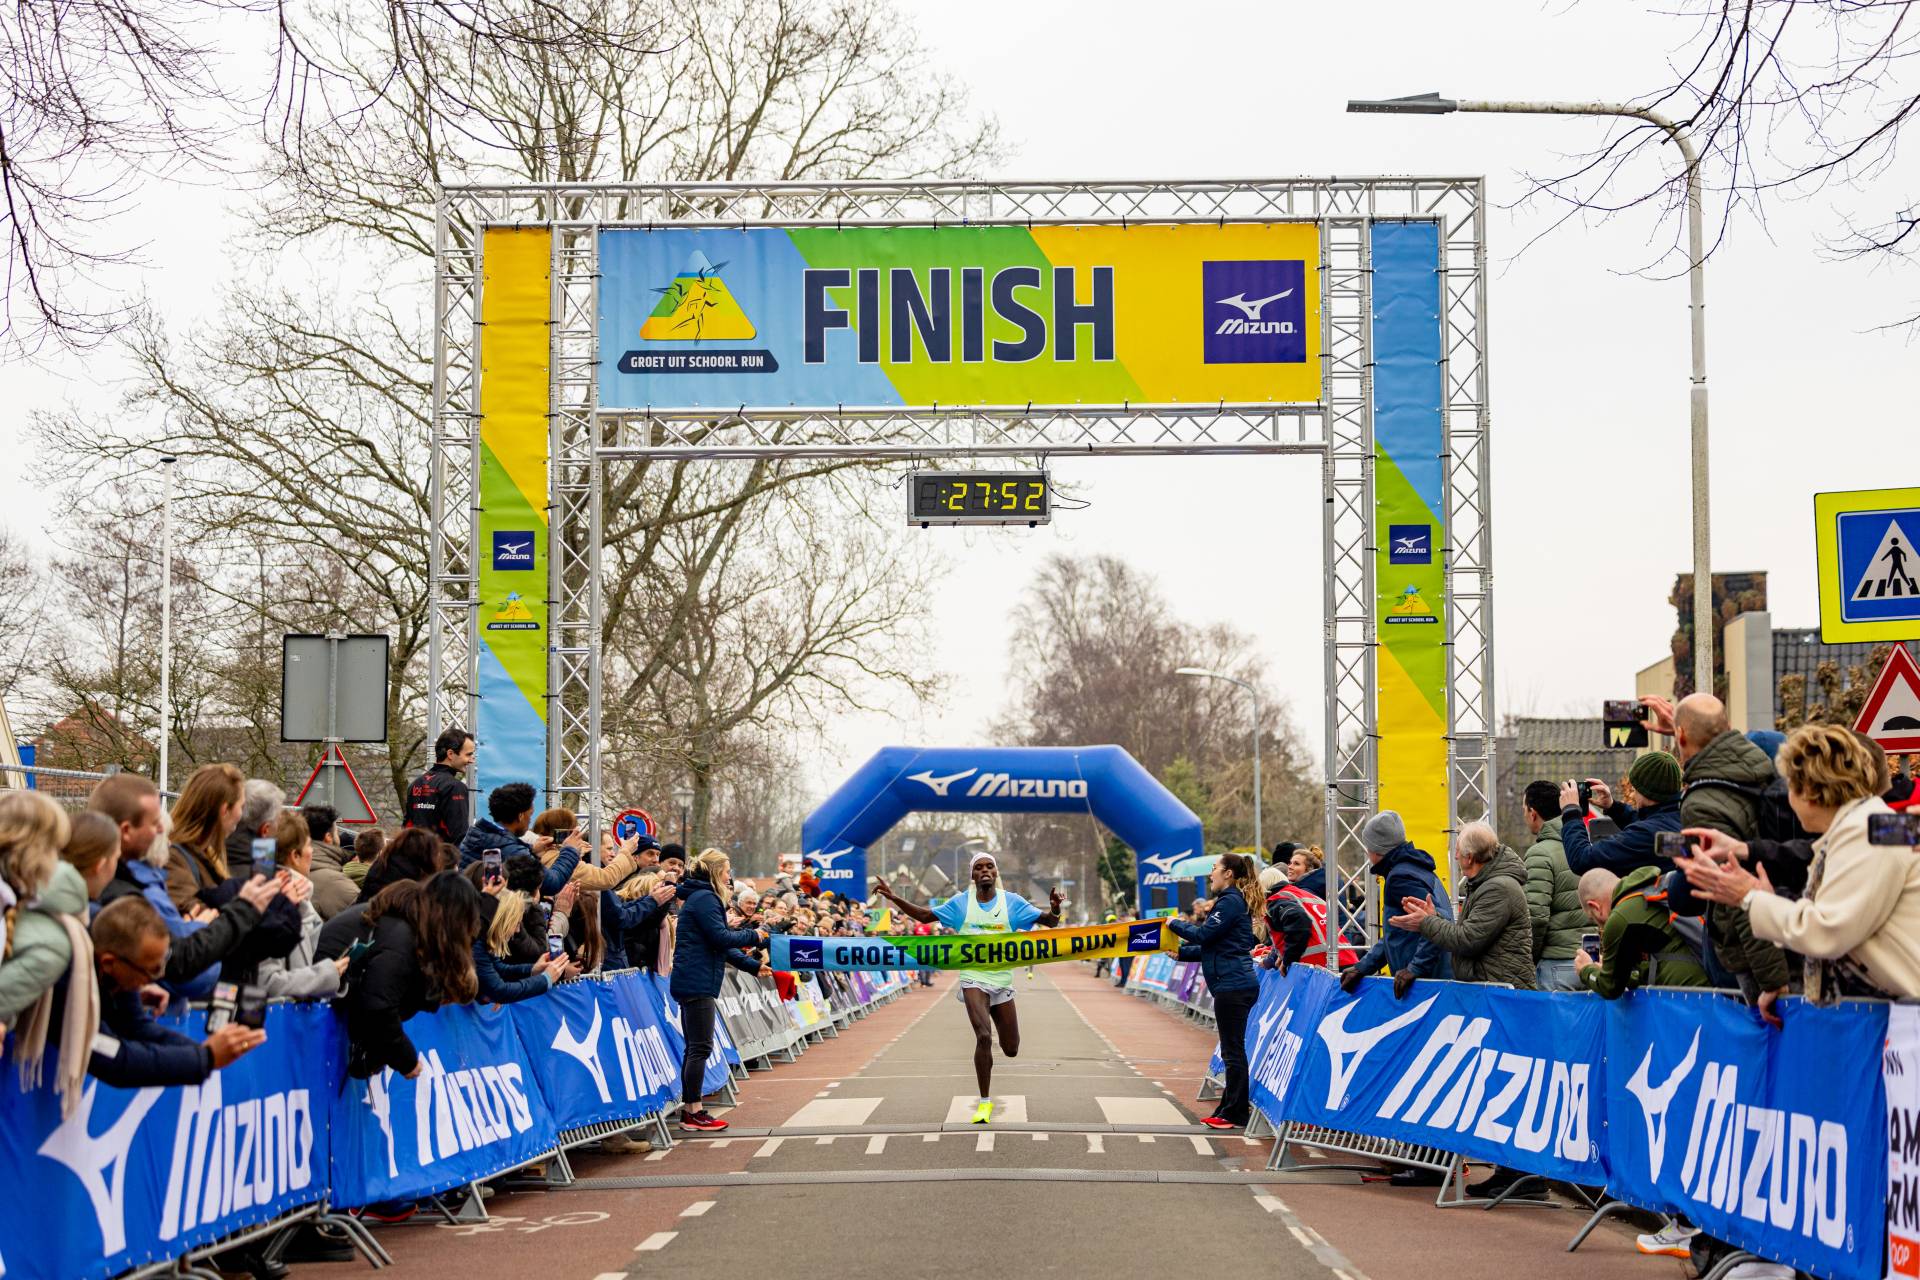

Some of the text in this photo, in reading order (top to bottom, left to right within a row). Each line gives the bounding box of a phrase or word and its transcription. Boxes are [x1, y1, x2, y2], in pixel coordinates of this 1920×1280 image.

[802, 265, 1116, 364] FINISH
[1215, 318, 1294, 335] MIZUNO
[630, 356, 764, 368] GROET UIT SCHOORL RUN
[966, 773, 1088, 798] MIZUNO
[819, 868, 854, 879] ZUNO
[835, 933, 1117, 966] GROET UIT SCHOORL RUN
[1376, 1015, 1590, 1163] MIZUNO
[159, 1069, 314, 1242] MIZUNO
[1680, 1061, 1848, 1250] MIZUNO
